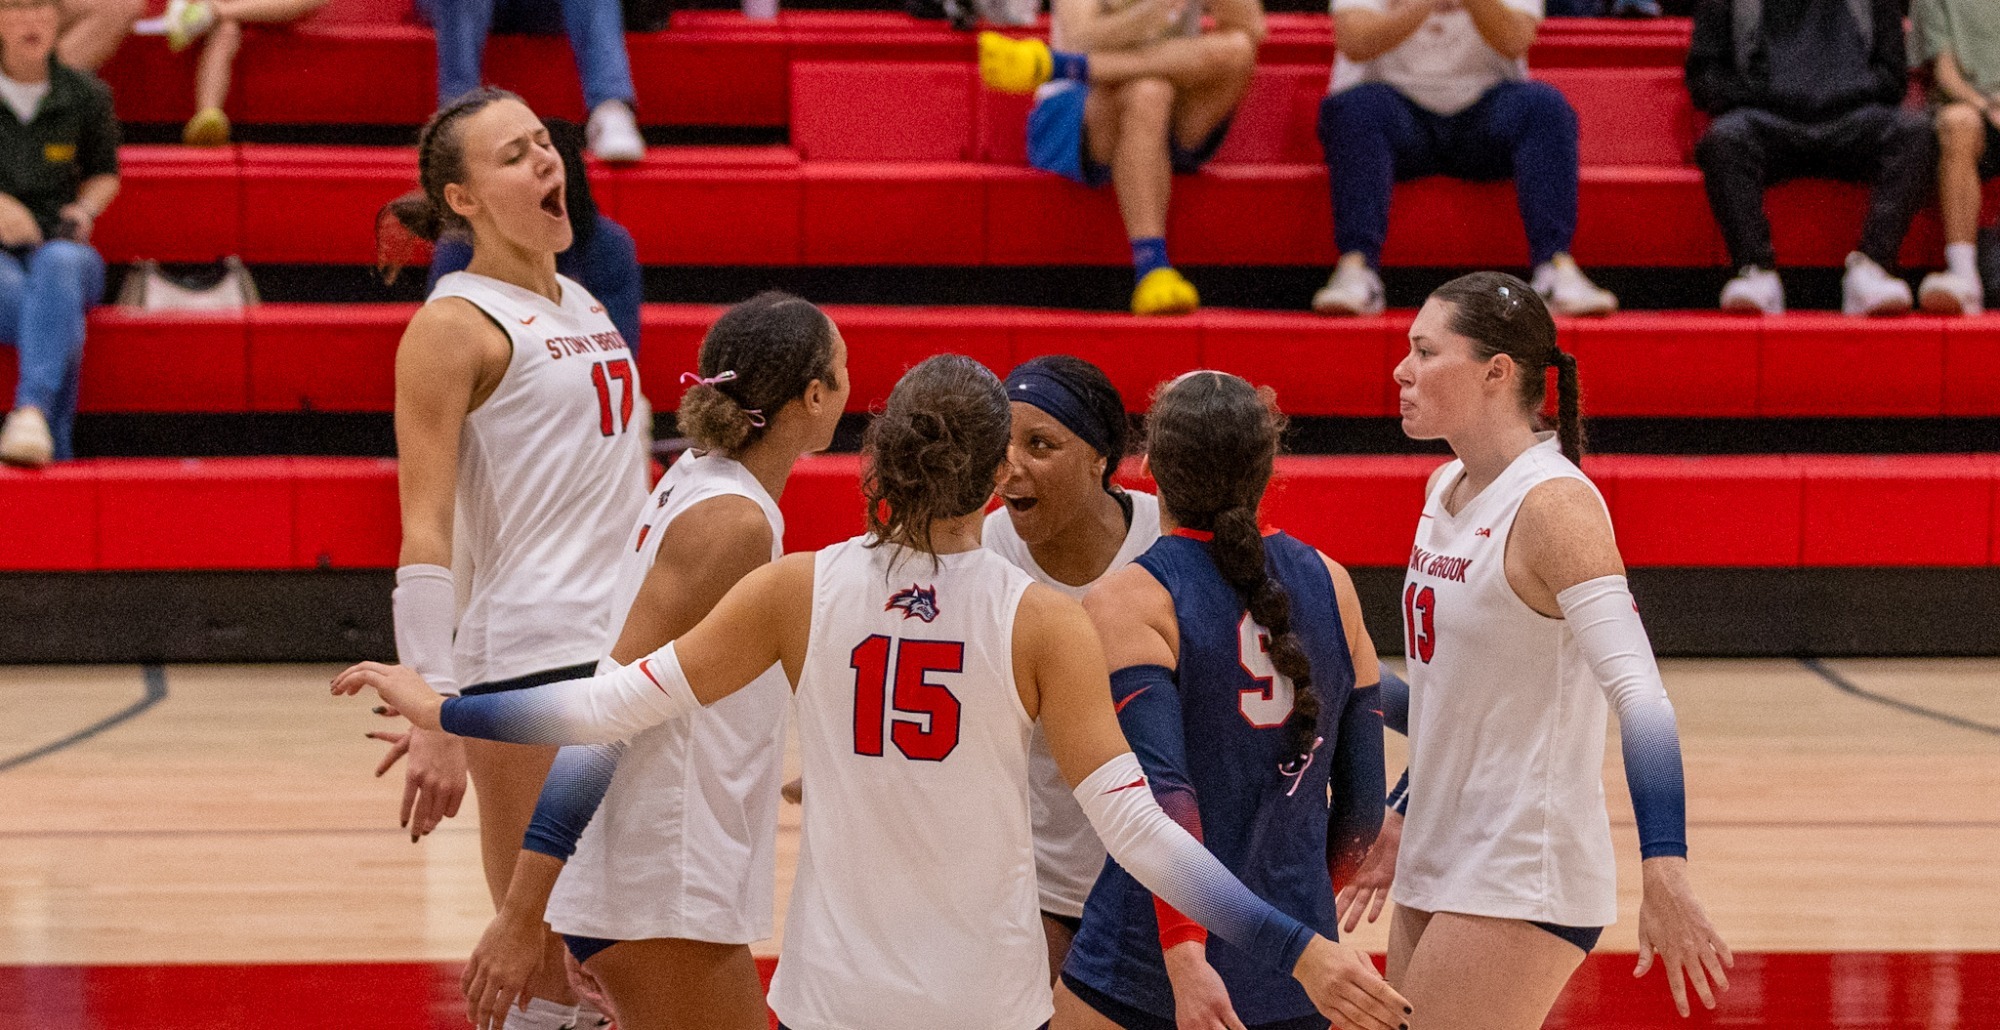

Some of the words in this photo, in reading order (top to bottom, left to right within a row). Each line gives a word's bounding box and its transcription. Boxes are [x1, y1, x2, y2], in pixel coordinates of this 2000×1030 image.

[546, 336, 596, 359] STONY
[590, 330, 627, 351] BROO
[591, 358, 634, 437] 17
[1428, 555, 1473, 583] BROOK
[1405, 581, 1435, 664] 13
[850, 633, 965, 762] 15
[1237, 608, 1296, 729] 9
